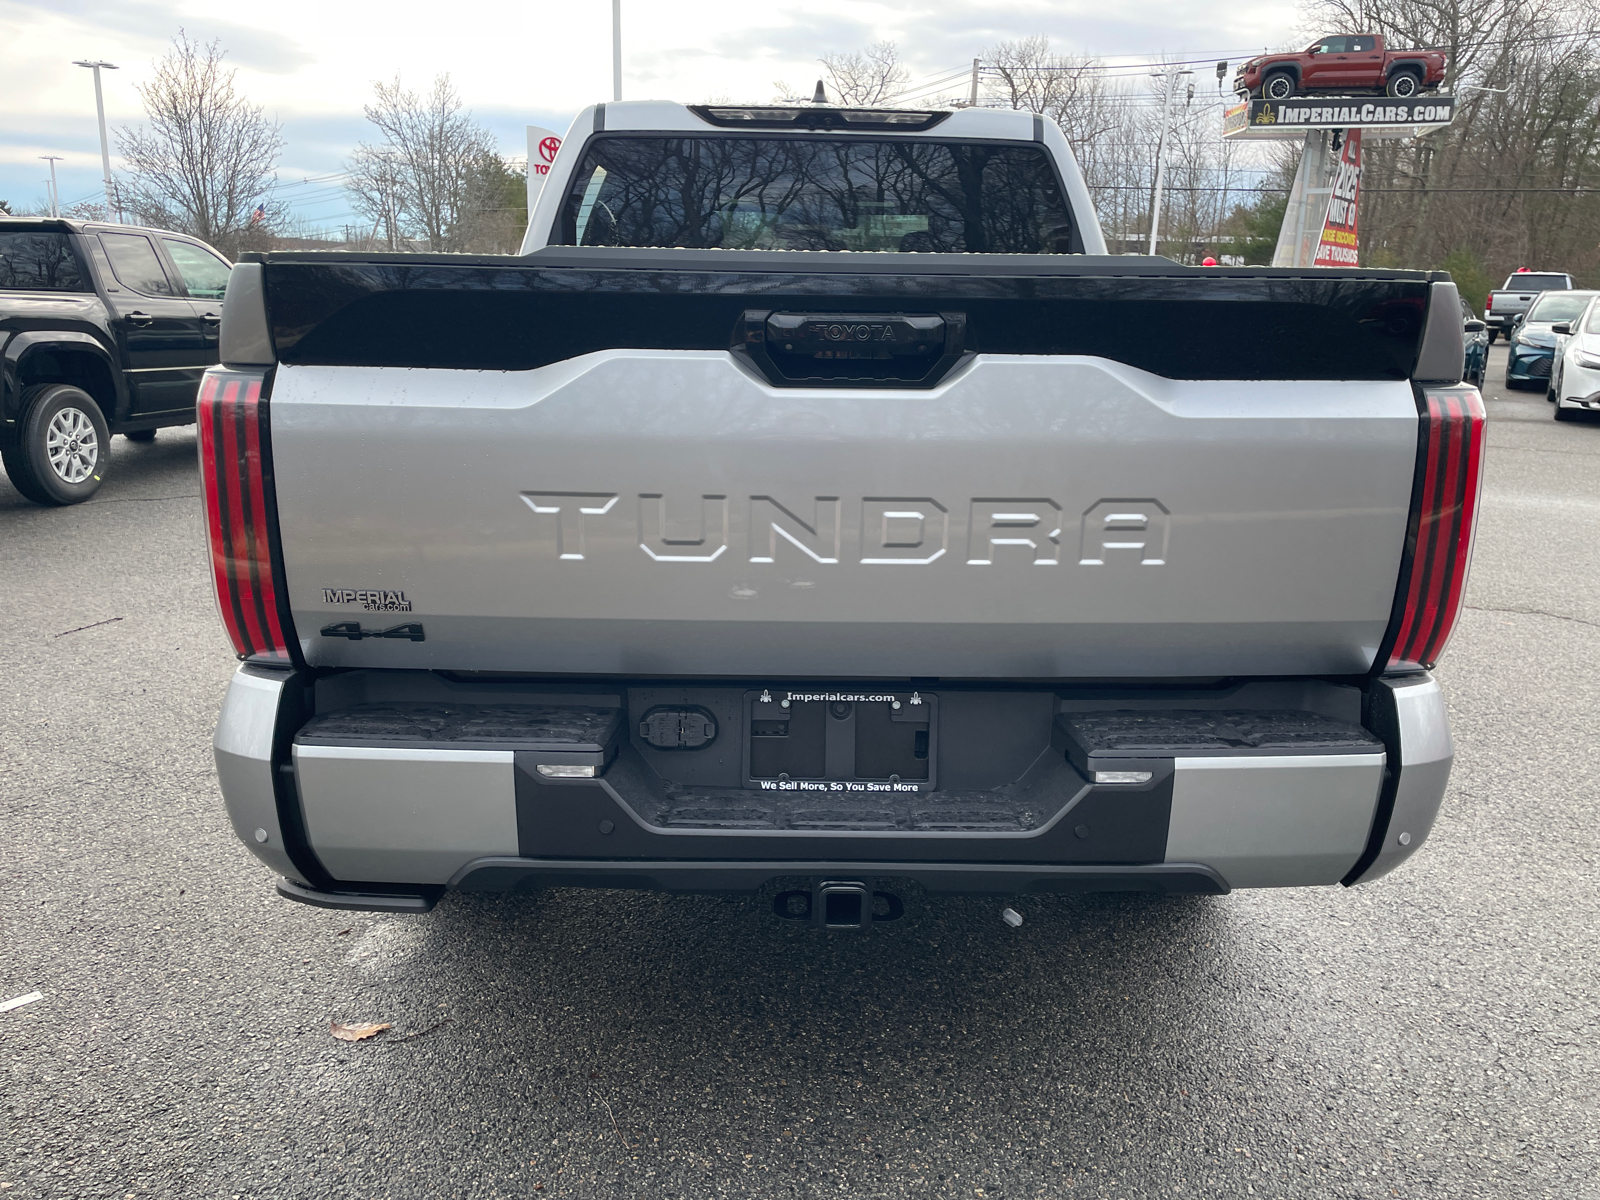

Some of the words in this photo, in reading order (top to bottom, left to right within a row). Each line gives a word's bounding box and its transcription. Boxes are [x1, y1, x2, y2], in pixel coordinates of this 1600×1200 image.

[815, 324, 896, 341] TOYOTA
[519, 490, 1171, 566] TUNDRA
[322, 588, 410, 605] IMPERIAL
[363, 602, 412, 612] cars.com
[786, 692, 896, 702] Imperialcars.com
[760, 781, 777, 790] We
[779, 781, 798, 790] Sell
[799, 782, 828, 792] More,
[830, 783, 843, 791] So
[846, 783, 865, 791] You
[867, 783, 891, 792] Save
[893, 784, 919, 792] More
